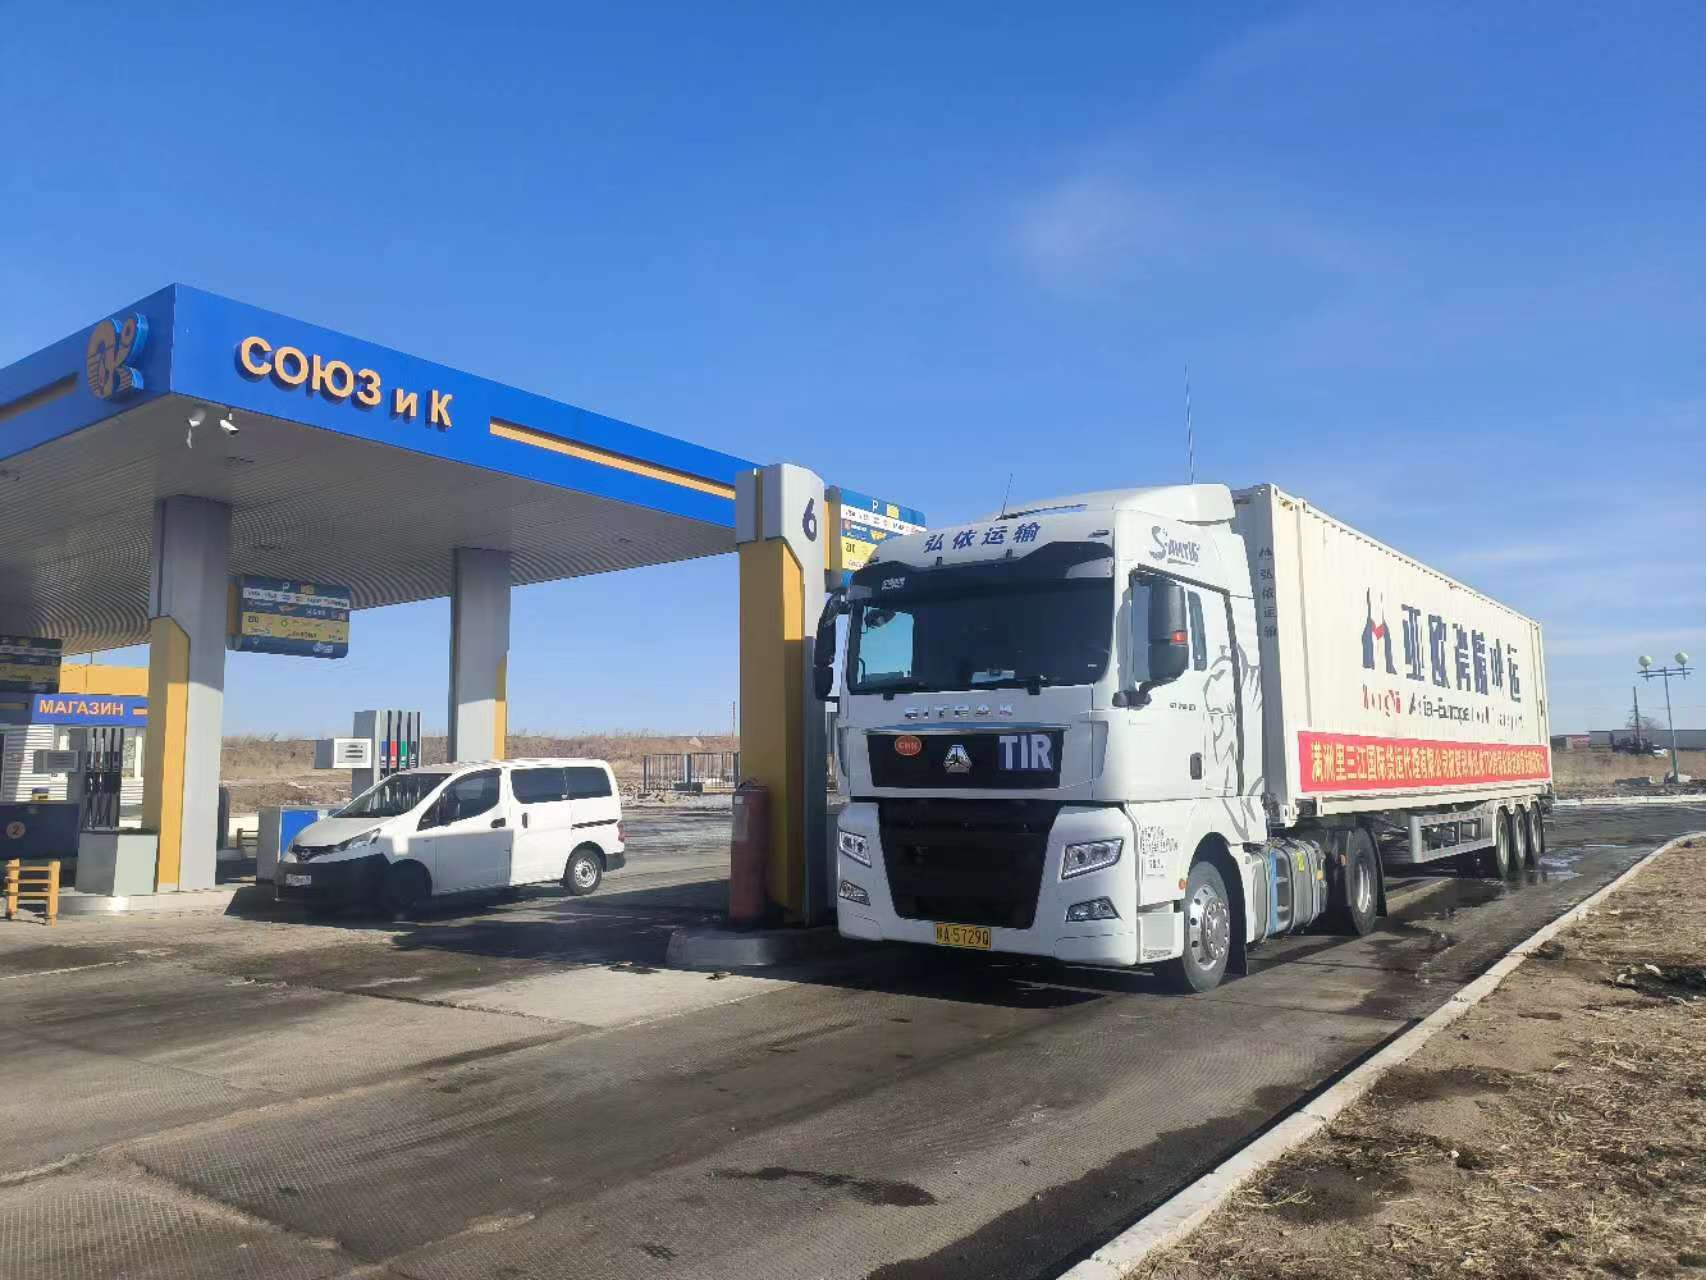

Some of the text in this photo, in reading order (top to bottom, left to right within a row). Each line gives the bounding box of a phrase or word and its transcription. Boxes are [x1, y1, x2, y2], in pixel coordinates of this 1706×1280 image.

[239, 335, 382, 407] СОЮЗ
[430, 389, 454, 428] К
[802, 497, 818, 542] 6
[923, 520, 1041, 553] 弘依运输
[39, 699, 125, 716] МАГАЗИН
[999, 734, 1052, 769] TIR
